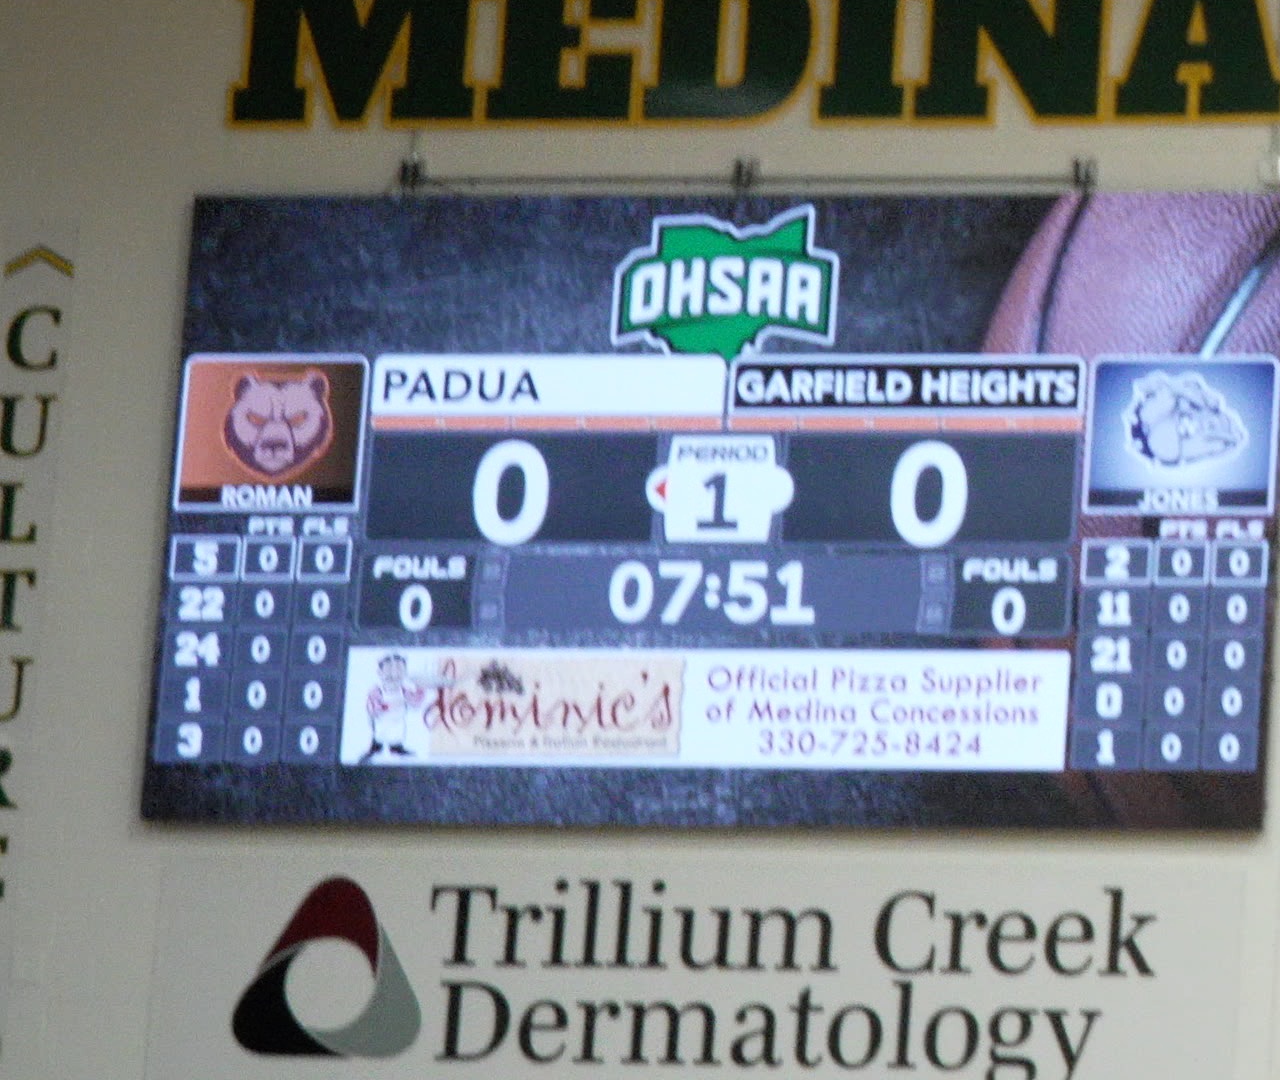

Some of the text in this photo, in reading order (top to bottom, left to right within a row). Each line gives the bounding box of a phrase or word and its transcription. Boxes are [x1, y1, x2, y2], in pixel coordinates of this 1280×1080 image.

[628, 255, 821, 327] OHSAA
[382, 369, 540, 403] PADUA
[737, 369, 1077, 406] GARFIELD HEIGHTS
[678, 444, 768, 462] PERIOD
[222, 484, 312, 508] ROMAN
[473, 439, 549, 546] 0
[697, 473, 738, 531] 1
[891, 440, 968, 548] 0
[1137, 488, 1218, 511] JONES
[193, 541, 335, 576] 5 0 0
[373, 555, 466, 579] FOULS
[962, 557, 1058, 583] FOULS
[1105, 544, 1250, 580] 2 0 0
[178, 586, 331, 622] 22 0 0
[400, 584, 433, 632] 0
[609, 560, 815, 625] 07:51
[1098, 591, 1248, 627] 11 0 0
[991, 587, 1026, 636] 0
[175, 631, 326, 668] 24 0 0
[1090, 637, 1245, 673] 21 0 0
[184, 677, 323, 713] 1 0 0
[706, 665, 1043, 698] Official Pizza Supplier
[705, 698, 1040, 726] of Medina Concessions
[1095, 682, 1242, 719] 0 0 0
[176, 722, 319, 758] 3 0 0
[758, 730, 982, 757] 330-725-8424
[1096, 729, 1240, 766] 1 0 0
[429, 876, 1158, 979] Trillium Creek
[432, 978, 1103, 1080] Dermatology
